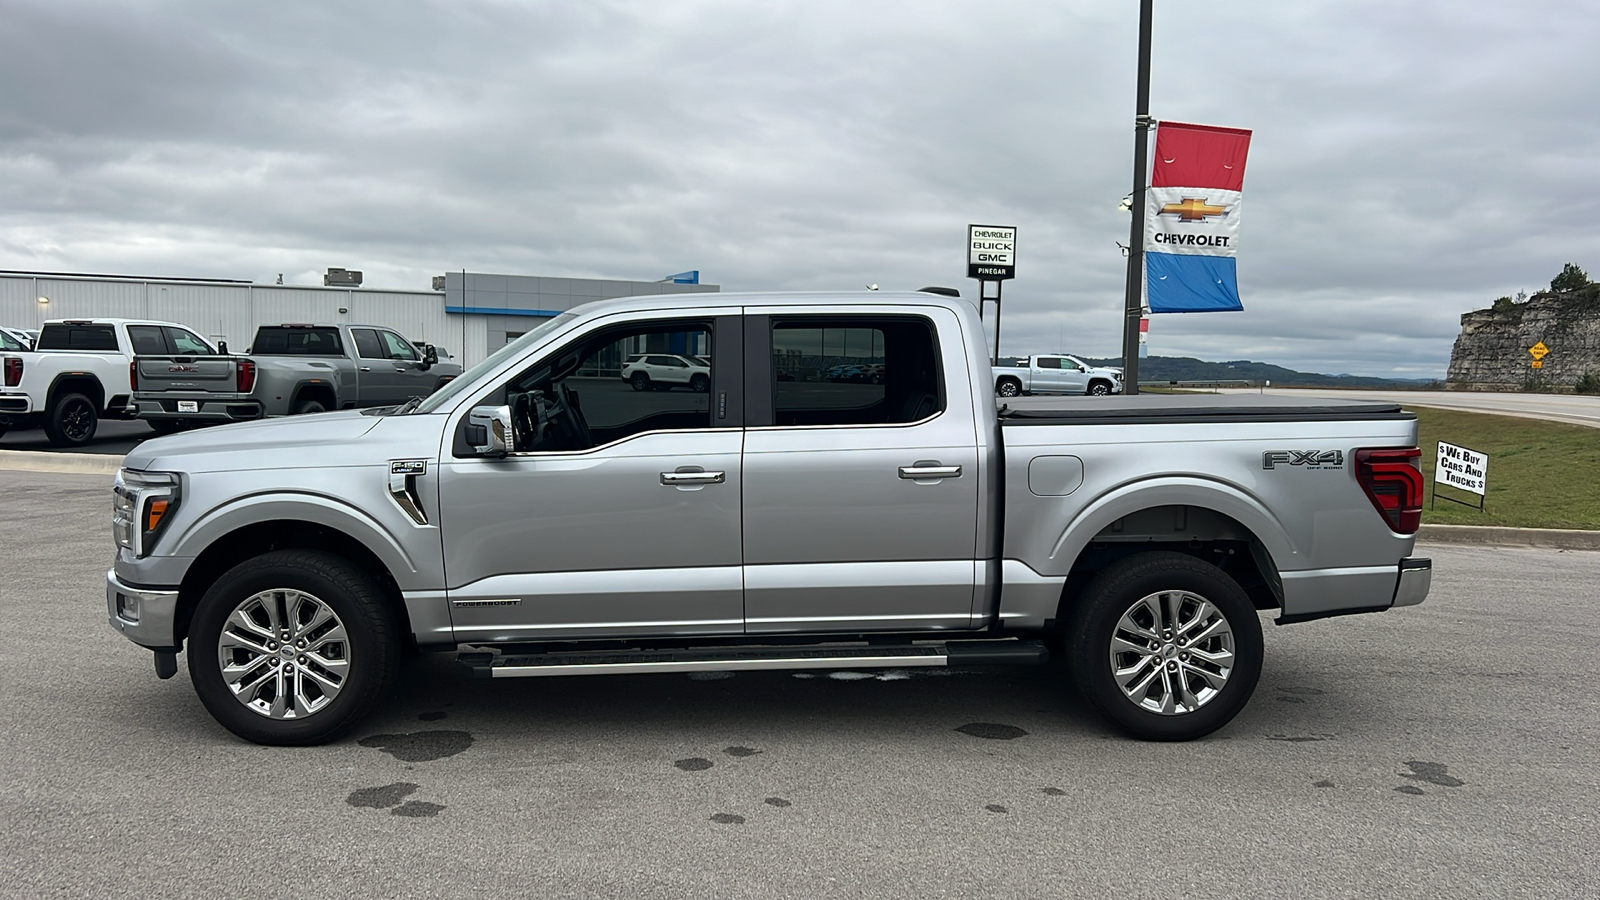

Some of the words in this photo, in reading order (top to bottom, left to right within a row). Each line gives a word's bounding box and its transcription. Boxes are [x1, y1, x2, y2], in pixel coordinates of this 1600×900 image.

[974, 230, 1013, 239] CHEVROLET
[1154, 232, 1230, 247] CHEVROLET
[973, 242, 1013, 251] BUICK
[978, 253, 1007, 262] GMC
[977, 267, 1007, 275] PINEGAR
[1262, 450, 1343, 470] FX4
